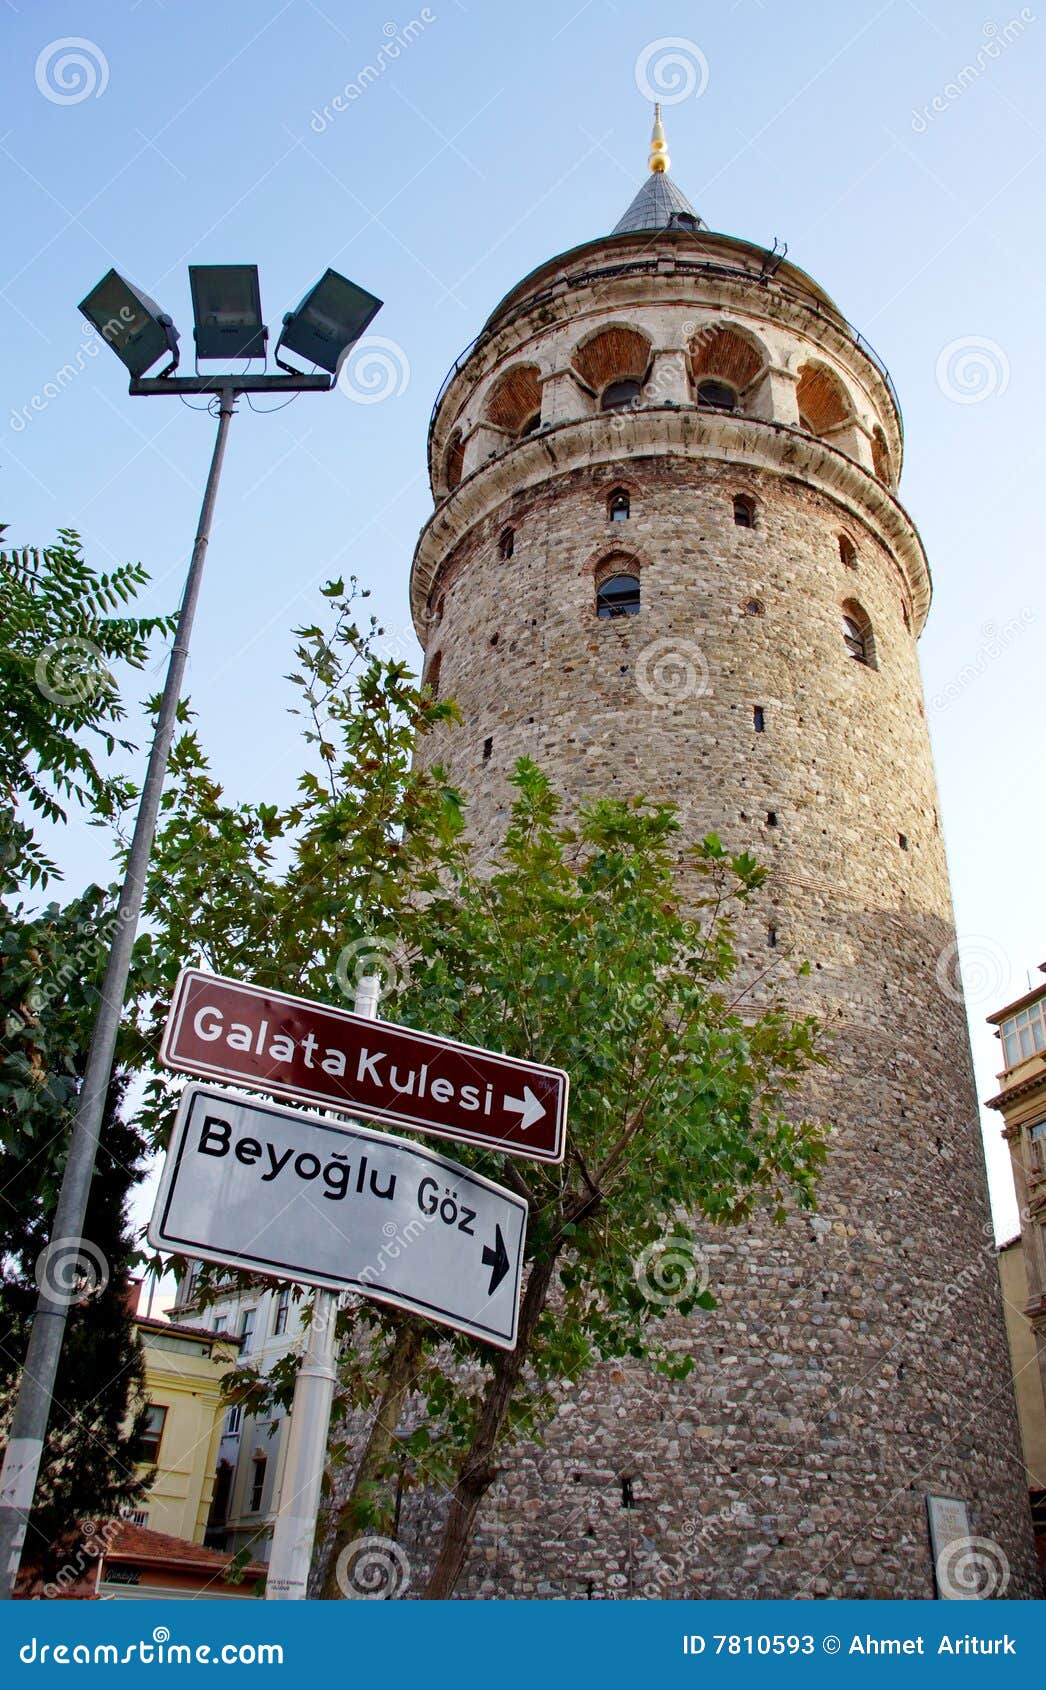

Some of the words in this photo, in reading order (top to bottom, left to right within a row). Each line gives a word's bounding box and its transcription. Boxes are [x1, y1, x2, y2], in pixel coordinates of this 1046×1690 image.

[193, 1005, 347, 1077] Galata
[356, 1047, 494, 1116] Kulesi
[197, 1115, 397, 1201] Beyoğlu
[417, 1176, 477, 1237] Göz
